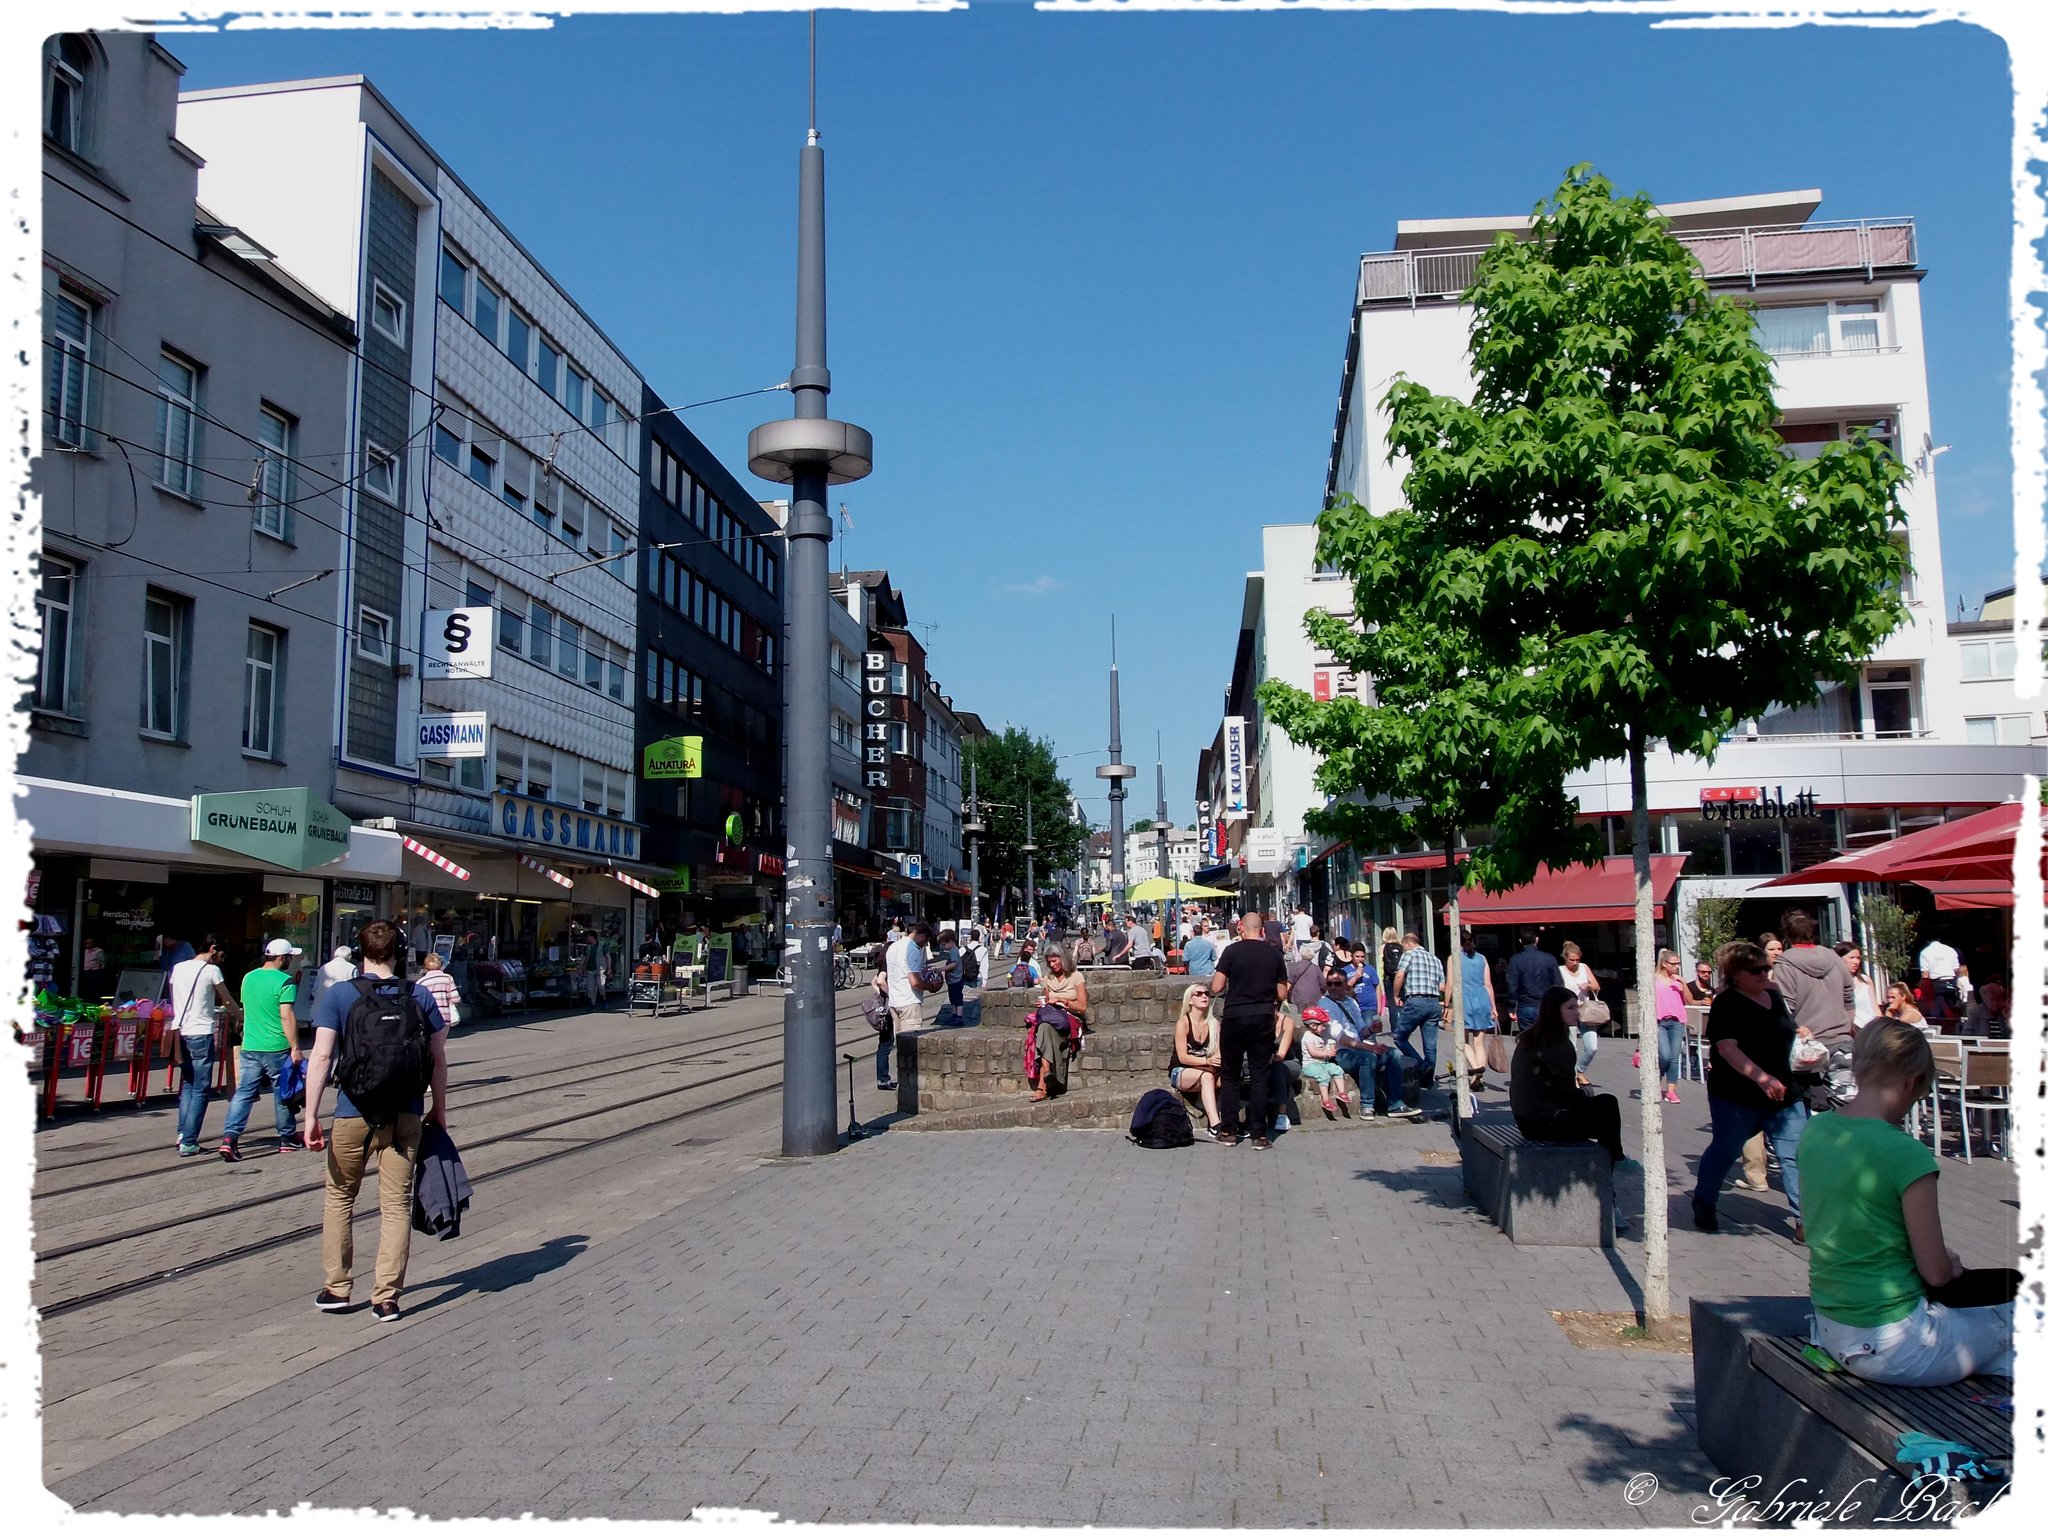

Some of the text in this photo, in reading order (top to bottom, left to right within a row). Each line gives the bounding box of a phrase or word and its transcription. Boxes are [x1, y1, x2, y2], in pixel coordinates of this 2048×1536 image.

[420, 724, 483, 745] GASSMANN
[1230, 726, 1241, 795] KLAUSER
[256, 802, 292, 817] SCHUH
[1702, 785, 1821, 821] extrablatt
[208, 812, 297, 835] GRÜNEBAUM
[312, 810, 329, 824] SCHUH
[307, 824, 348, 844] GRÜNEBAUM
[503, 799, 634, 857] GASSMANN
[361, 887, 374, 902] 32a
[23, 1033, 46, 1043] ALLES
[73, 1029, 94, 1038] ALLES
[118, 1025, 137, 1034] ALLES
[72, 1038, 93, 1060] 1€
[117, 1034, 136, 1054] 1€
